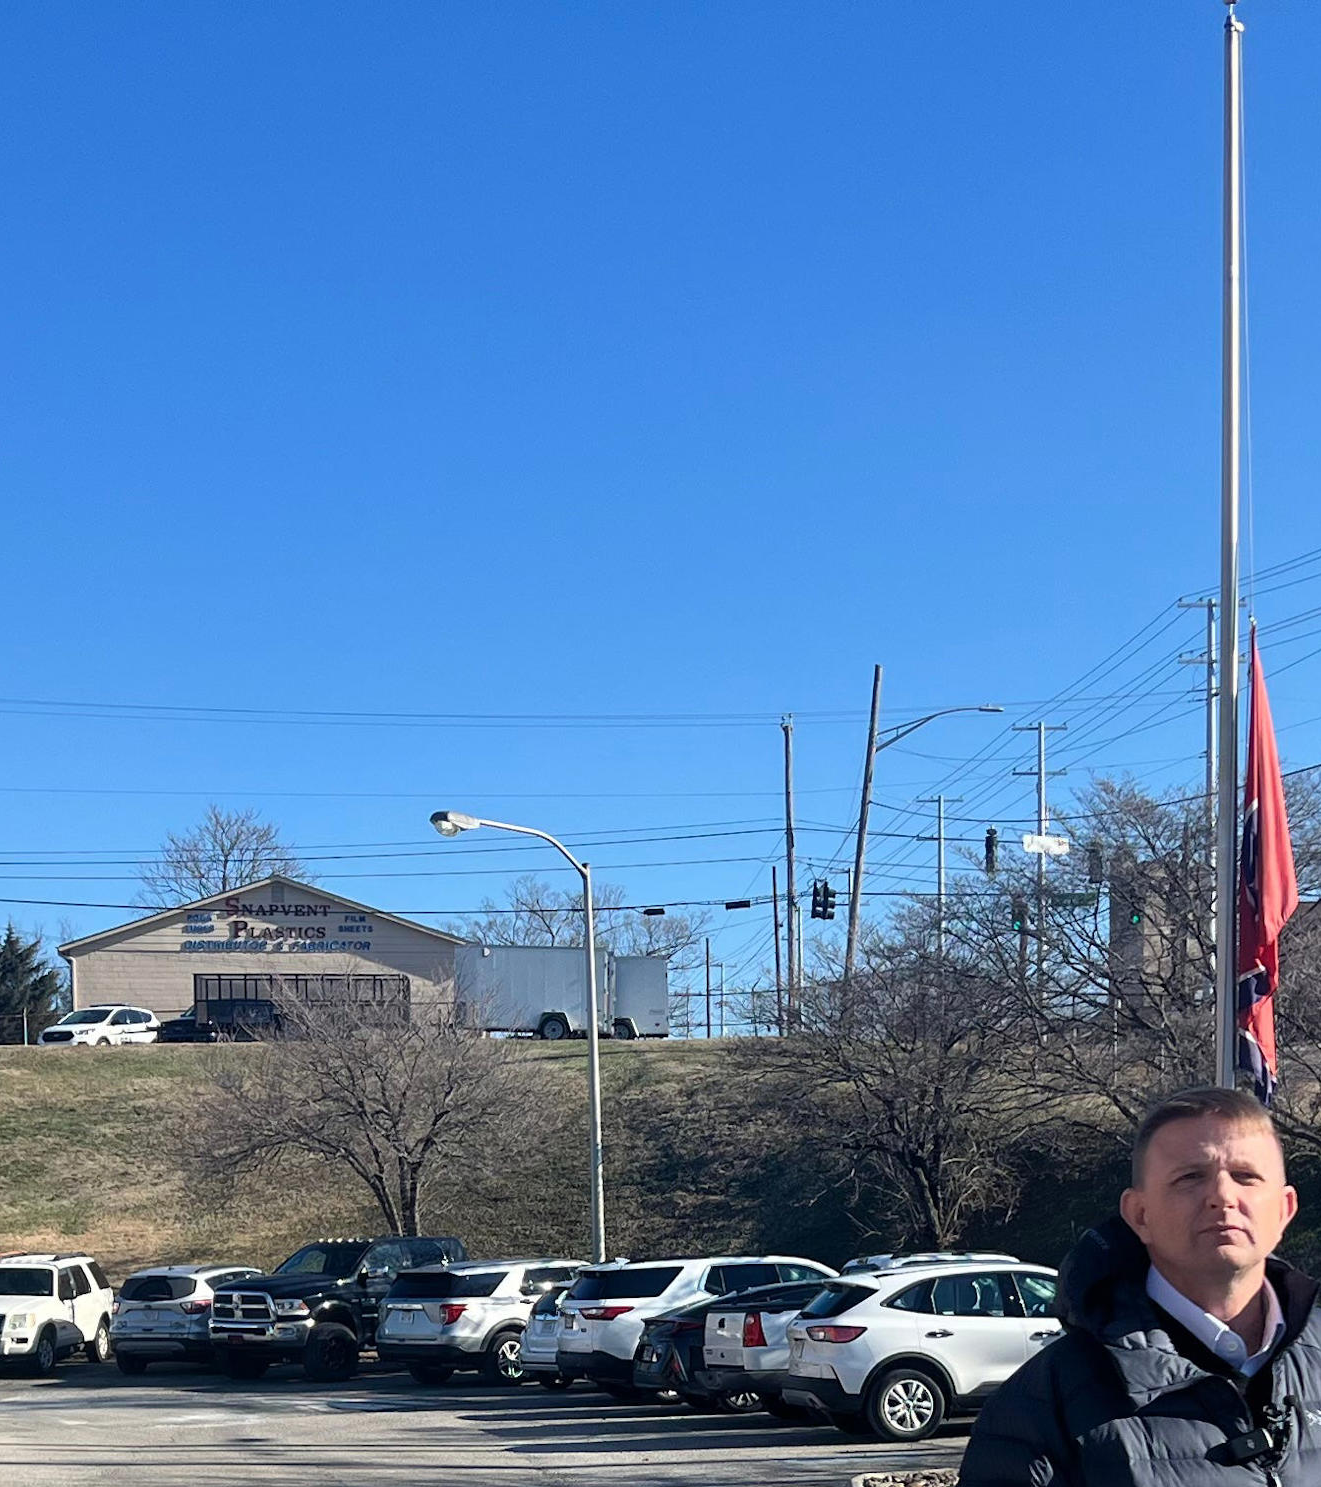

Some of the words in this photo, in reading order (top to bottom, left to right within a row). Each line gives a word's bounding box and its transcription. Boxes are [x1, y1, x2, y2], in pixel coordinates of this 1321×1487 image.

[225, 897, 331, 917] SNAPVENT
[344, 915, 367, 923] FILM
[229, 920, 327, 939] PLASTICS
[338, 925, 373, 933] SHEETS
